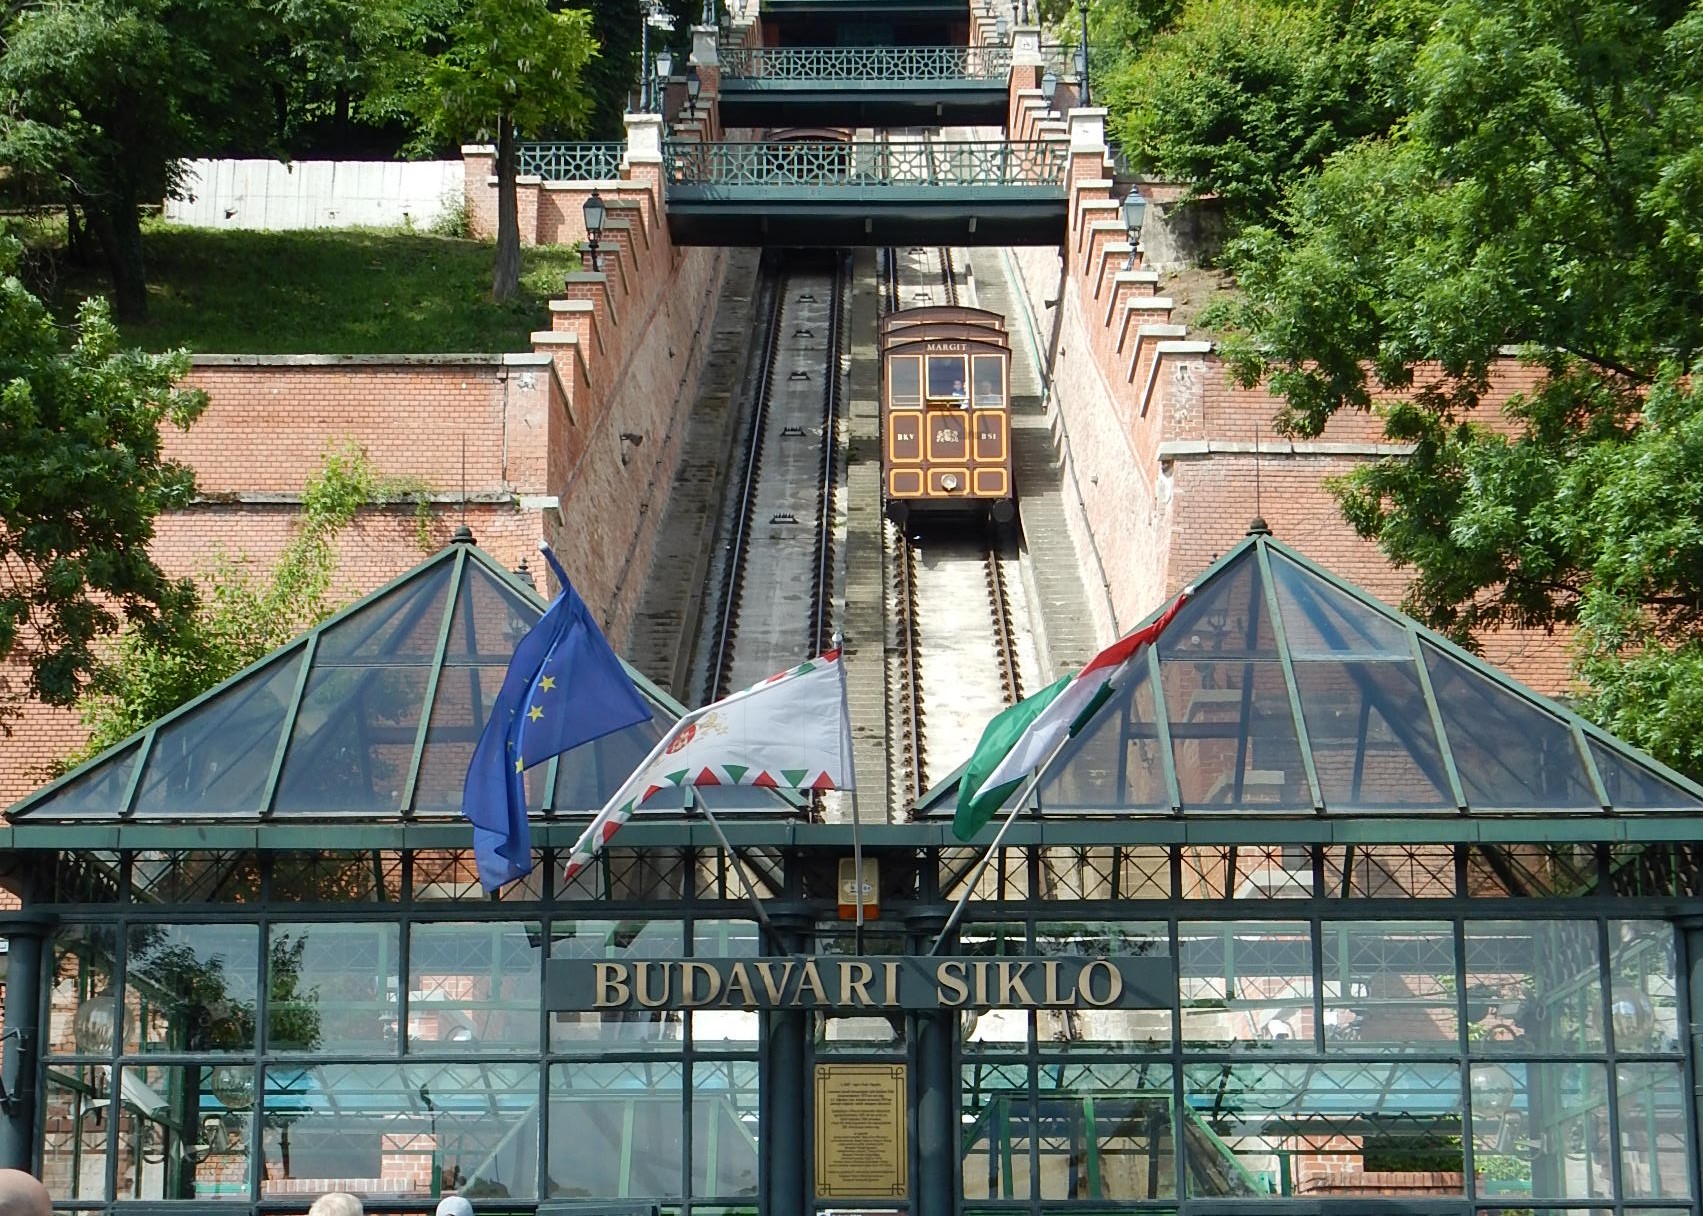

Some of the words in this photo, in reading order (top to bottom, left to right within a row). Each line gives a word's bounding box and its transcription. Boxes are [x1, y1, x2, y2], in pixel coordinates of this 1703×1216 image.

[926, 343, 968, 351] MARGIT
[897, 433, 915, 441] BKV
[592, 956, 901, 1008] BUDAVÁRI
[936, 955, 1123, 1006] SIKLÓ
